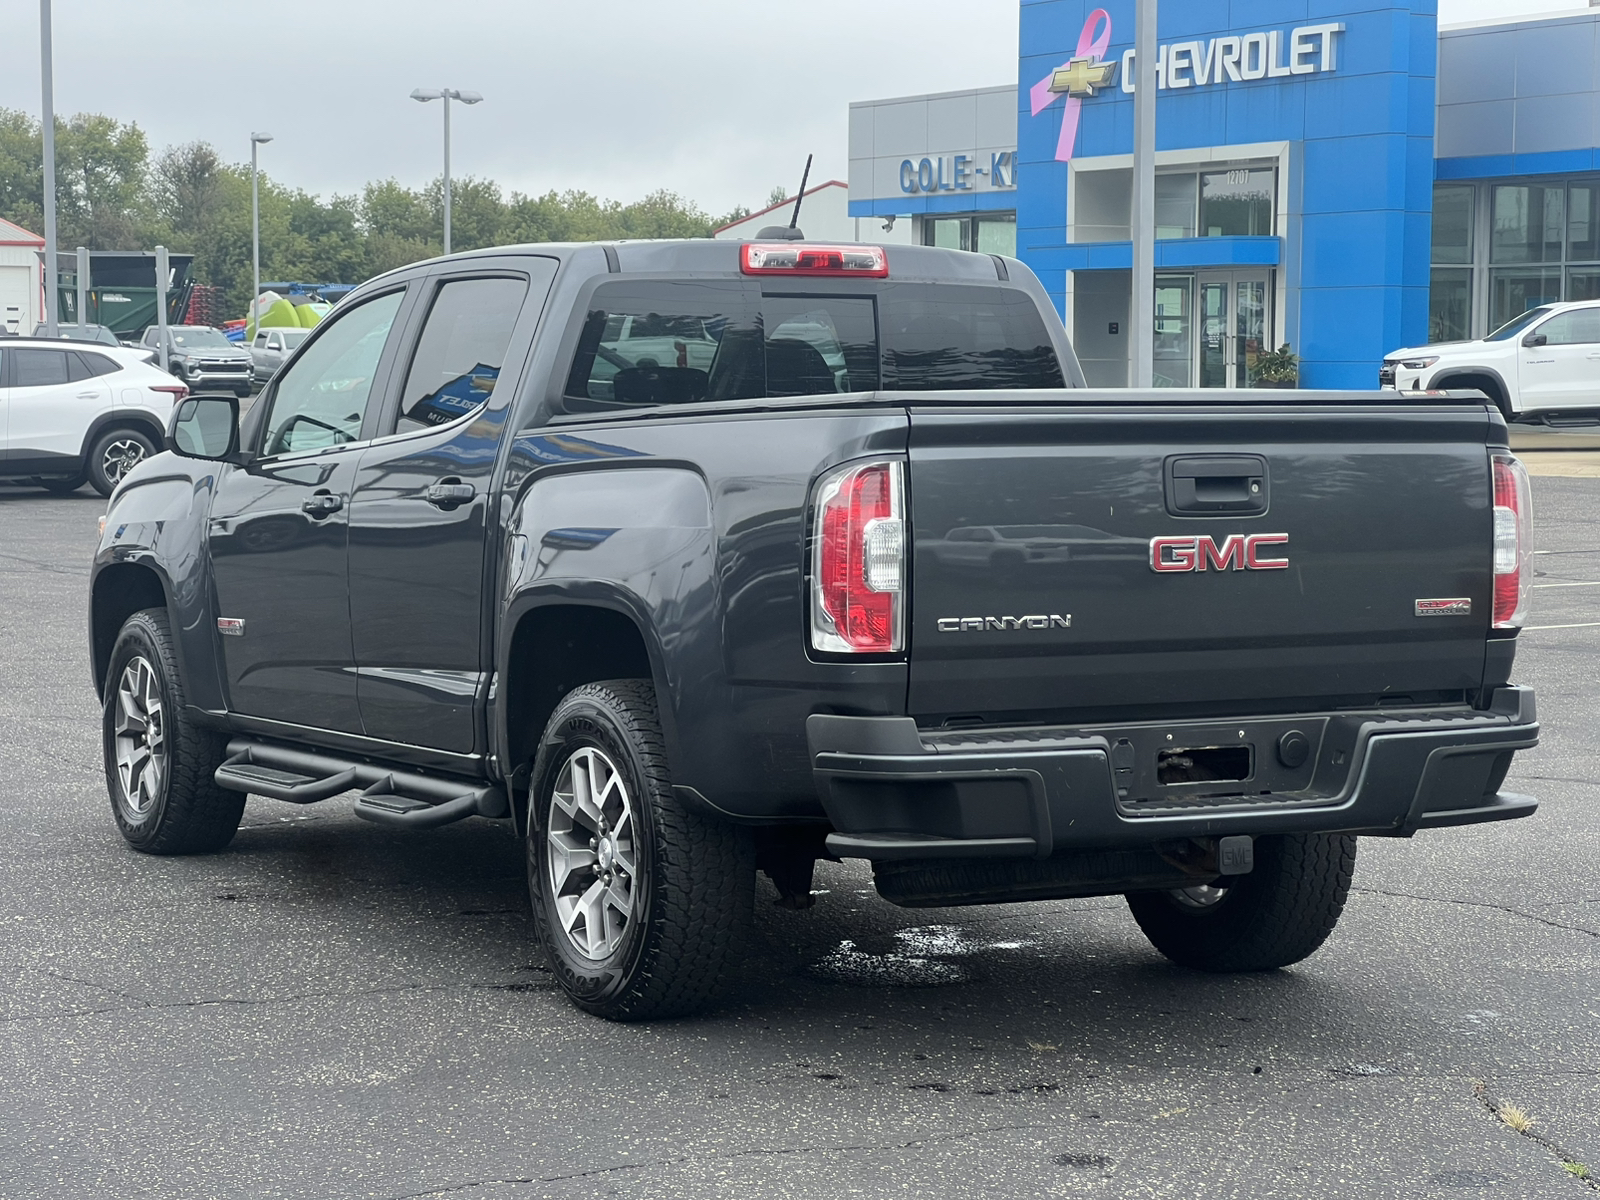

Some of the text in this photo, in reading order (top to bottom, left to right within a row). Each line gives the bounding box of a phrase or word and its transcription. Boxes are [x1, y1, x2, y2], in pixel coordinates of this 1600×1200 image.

[1227, 169, 1249, 185] 12707
[1150, 533, 1289, 572] GMC
[937, 614, 1072, 632] CANYON
[1222, 846, 1252, 867] GMC
